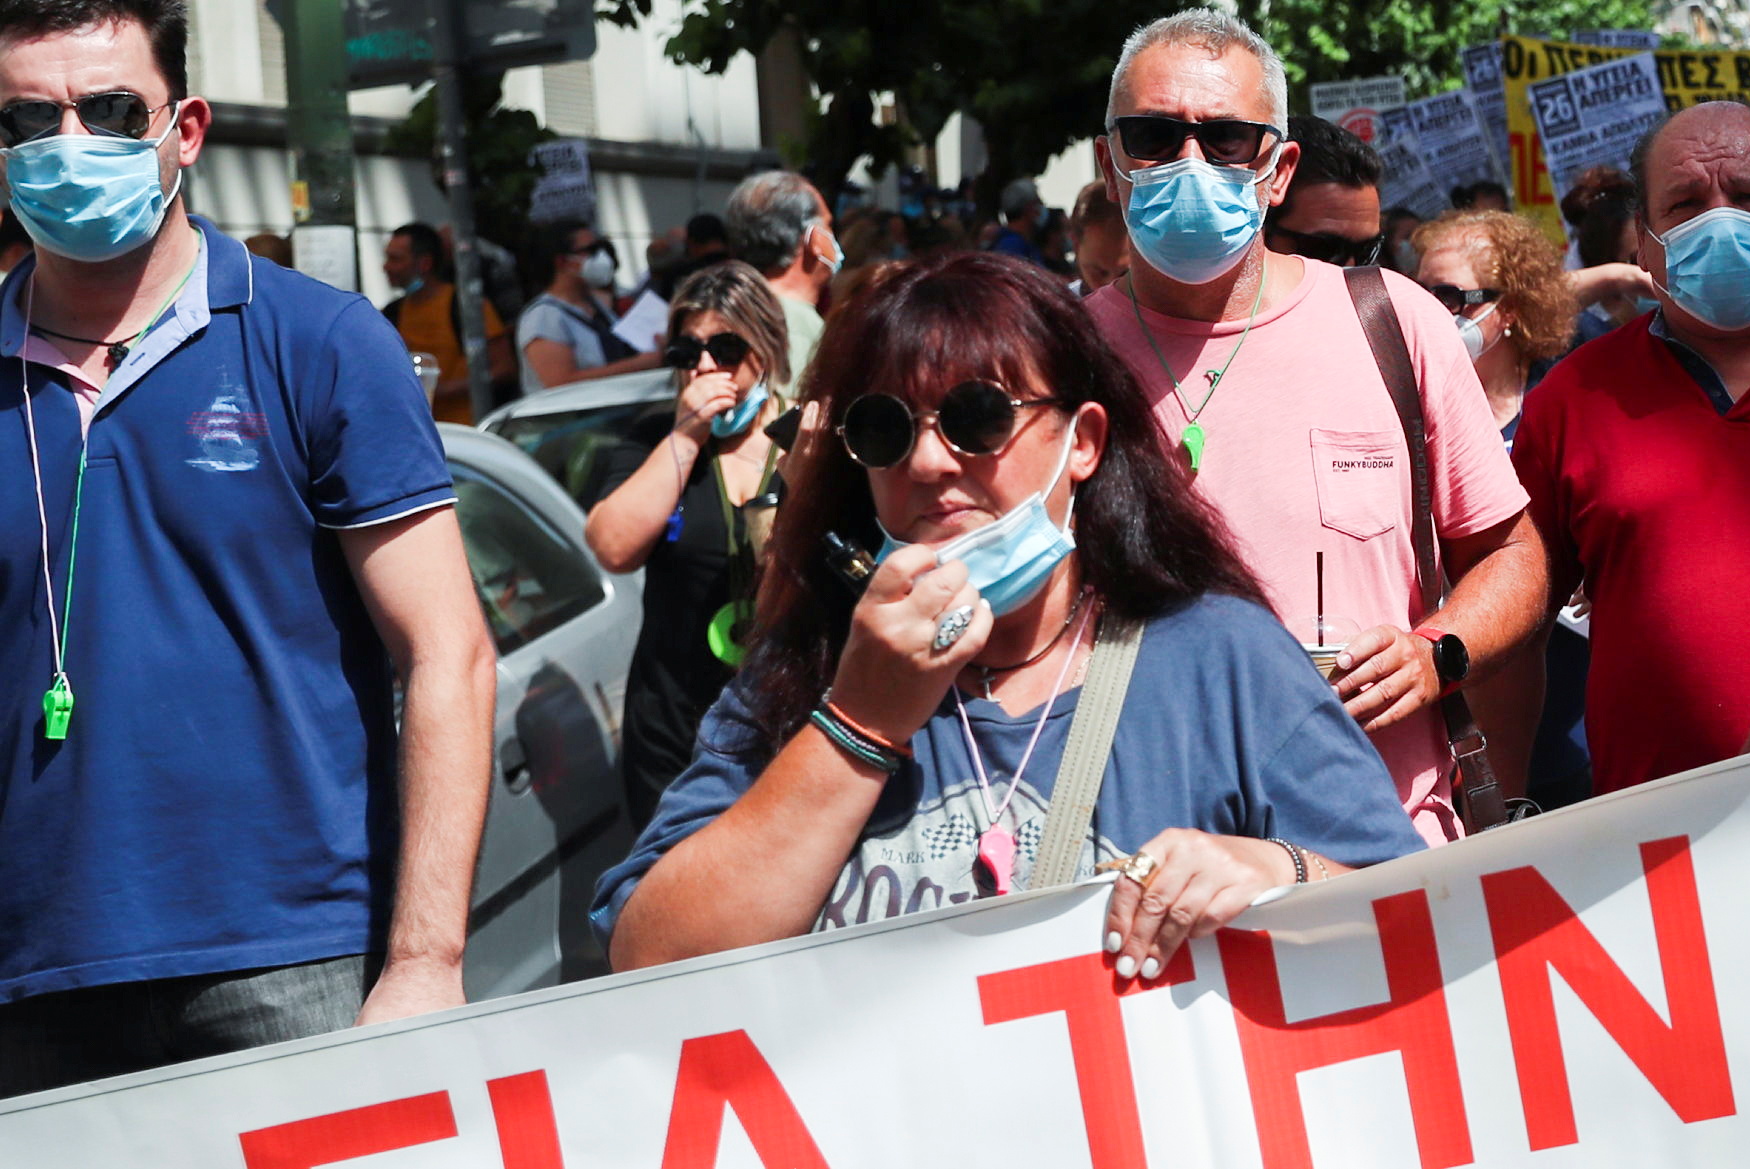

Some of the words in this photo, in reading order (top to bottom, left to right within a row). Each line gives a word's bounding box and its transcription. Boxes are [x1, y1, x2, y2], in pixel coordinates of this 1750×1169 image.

[1541, 93, 1573, 126] 26
[1332, 459, 1394, 470] FUNKYBUDDHA
[881, 847, 925, 864] MARK
[978, 848, 1737, 1169] ΤΗΝ
